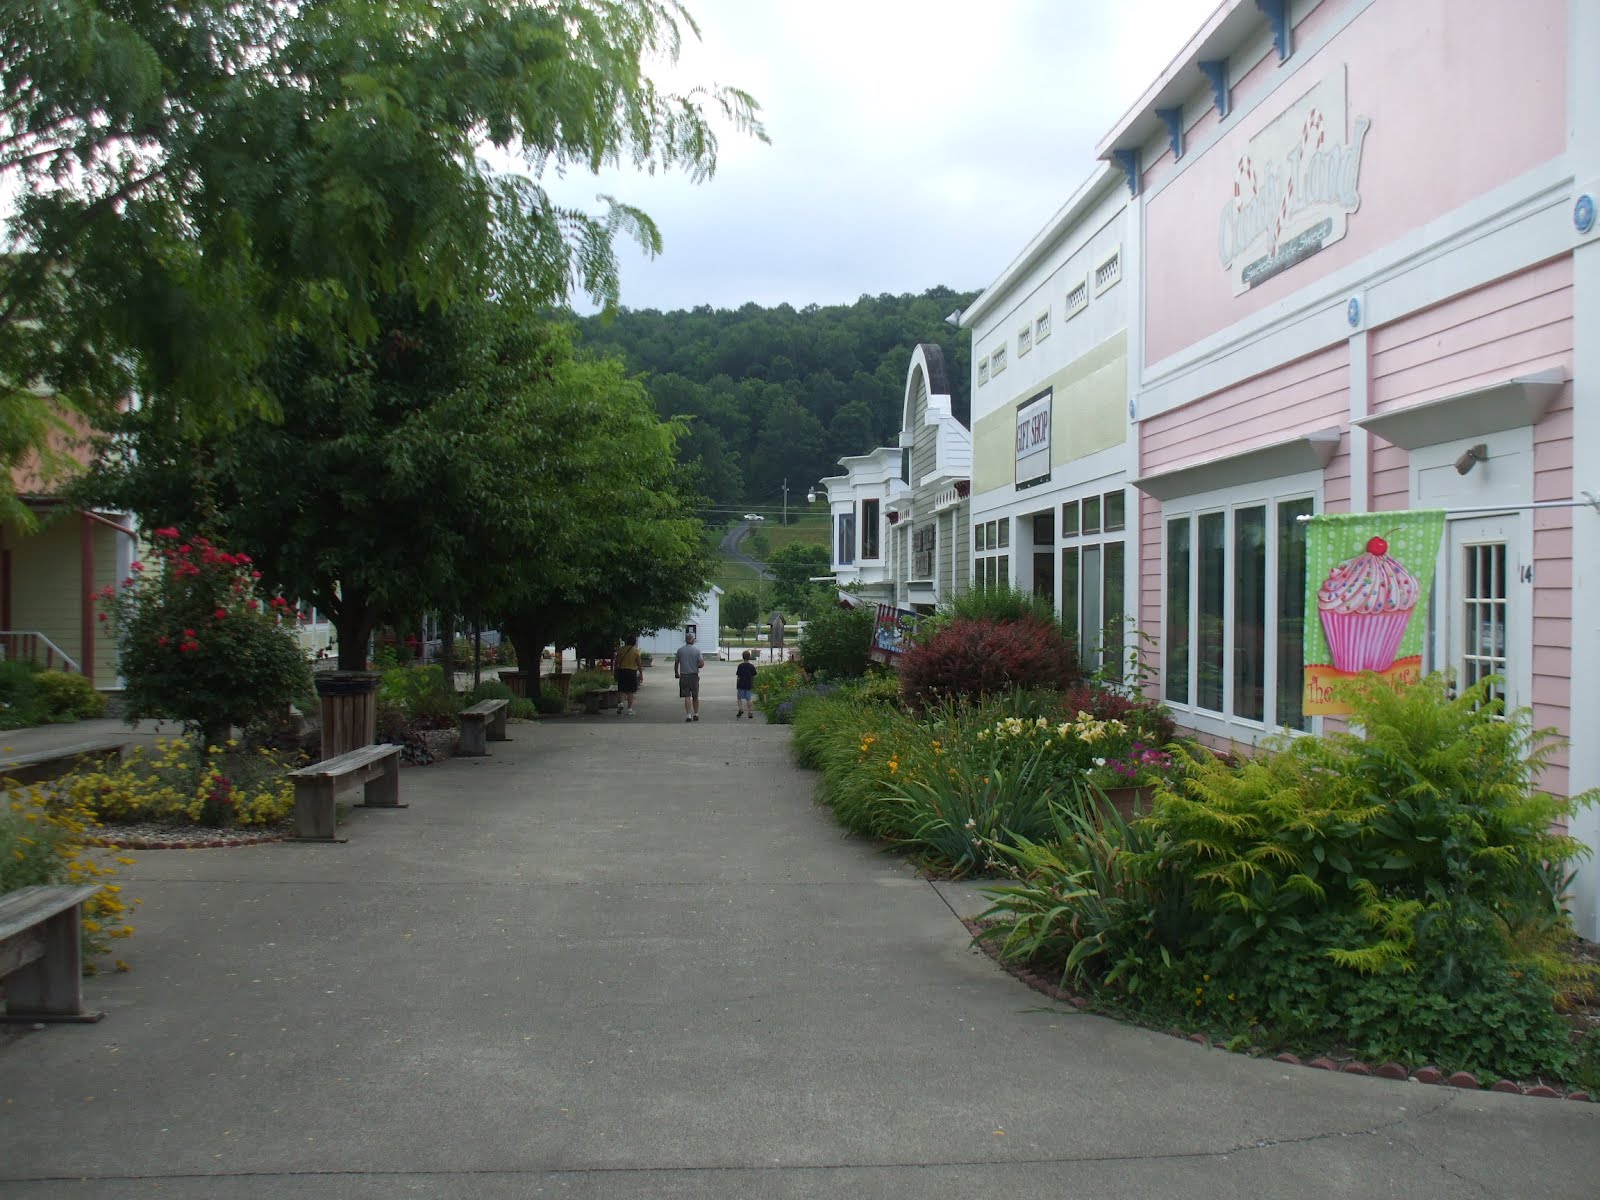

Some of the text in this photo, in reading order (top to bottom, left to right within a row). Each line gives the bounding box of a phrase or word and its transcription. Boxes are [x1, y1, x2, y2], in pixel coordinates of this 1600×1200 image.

[1286, 115, 1369, 217] Land
[1244, 256, 1274, 282] Sweets
[1285, 242, 1297, 258] the
[1297, 229, 1328, 251] Sweet
[1017, 411, 1048, 453] GIFT SHOP
[1520, 564, 1532, 584] 14
[1306, 673, 1333, 705] The
